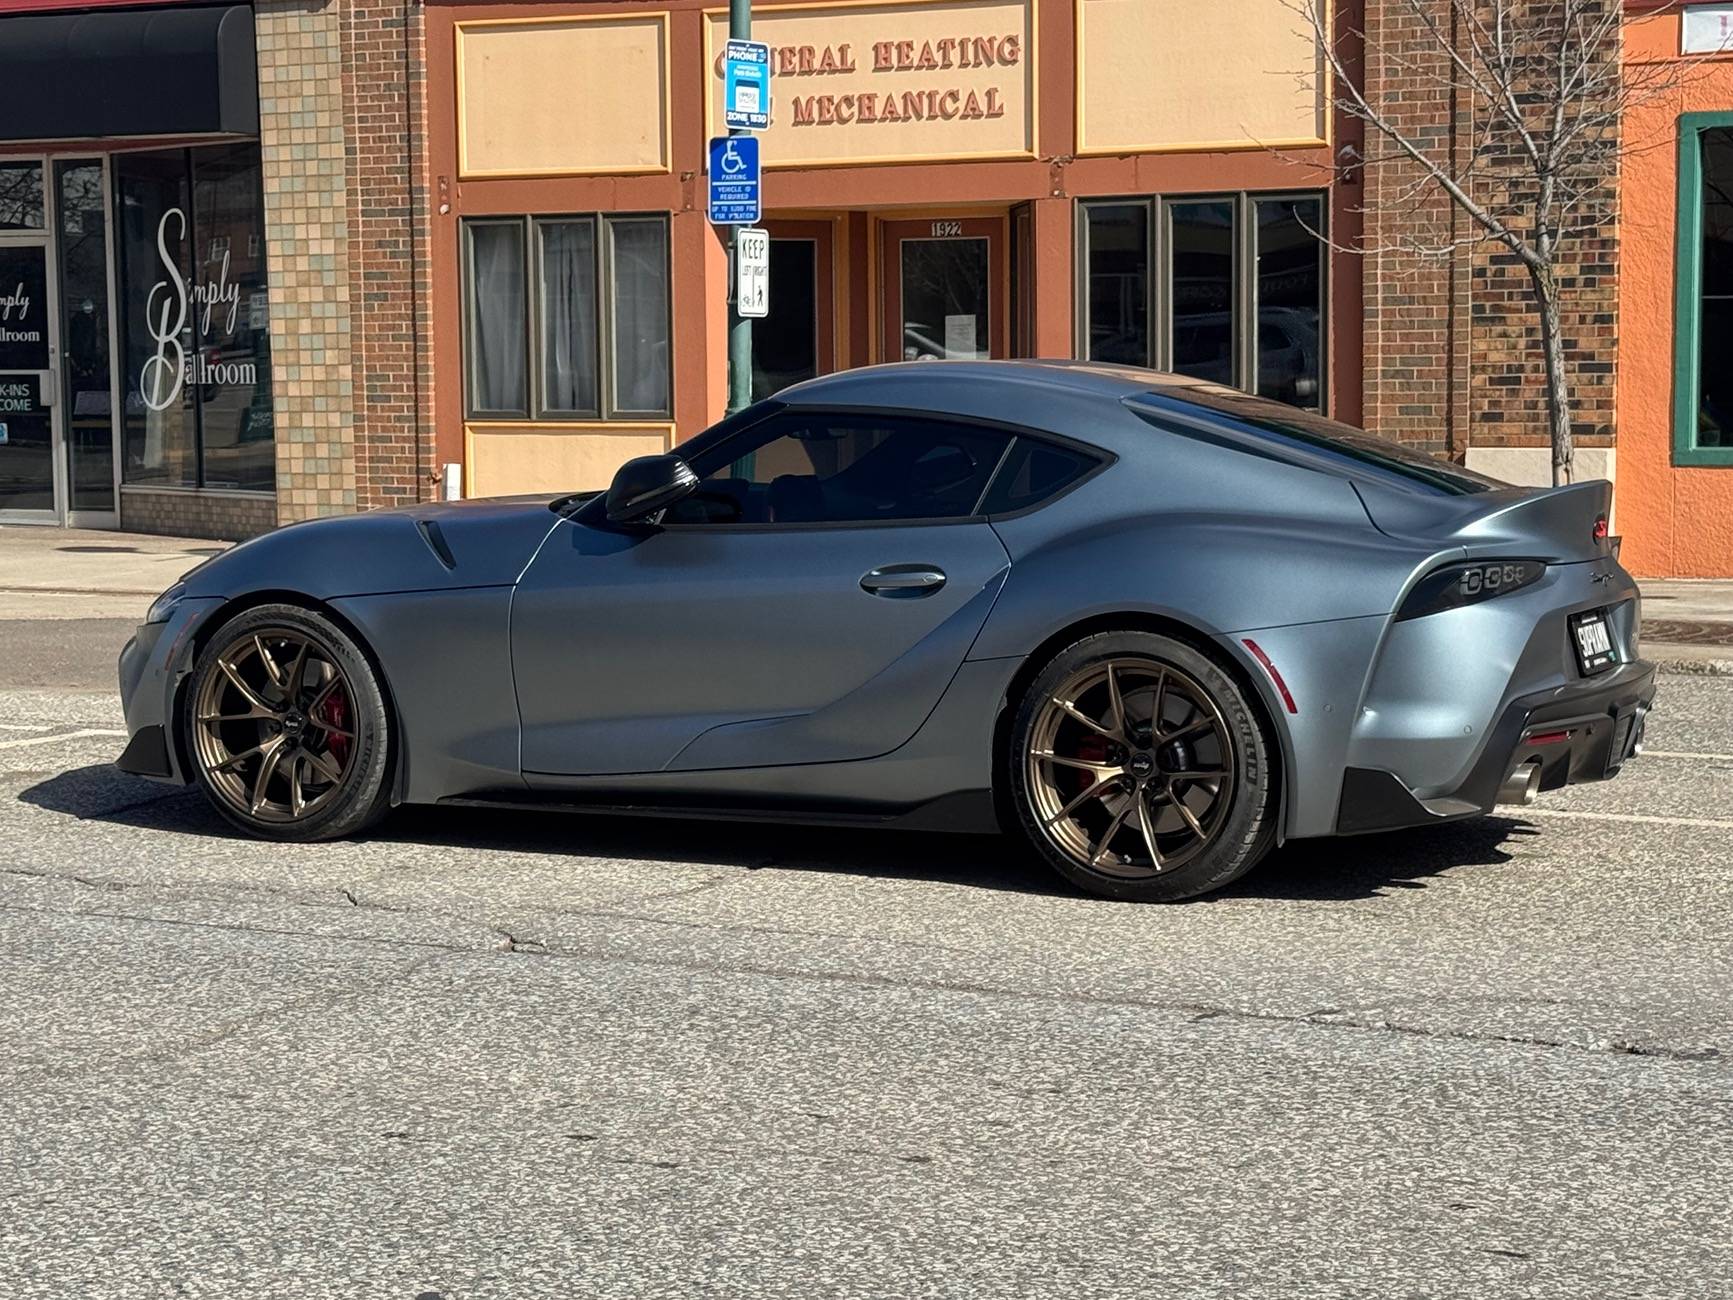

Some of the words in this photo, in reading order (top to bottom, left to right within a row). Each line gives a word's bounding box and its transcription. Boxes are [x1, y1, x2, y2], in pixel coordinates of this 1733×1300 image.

[728, 50, 758, 62] PHONE
[872, 34, 1021, 73] HEATING
[727, 111, 749, 122] ZONE
[791, 87, 1005, 128] MECHANICAL
[721, 173, 748, 181] PARKING
[931, 222, 962, 237] 1922
[742, 239, 765, 260] KEEP
[1222, 688, 1258, 784] MICHELIN
